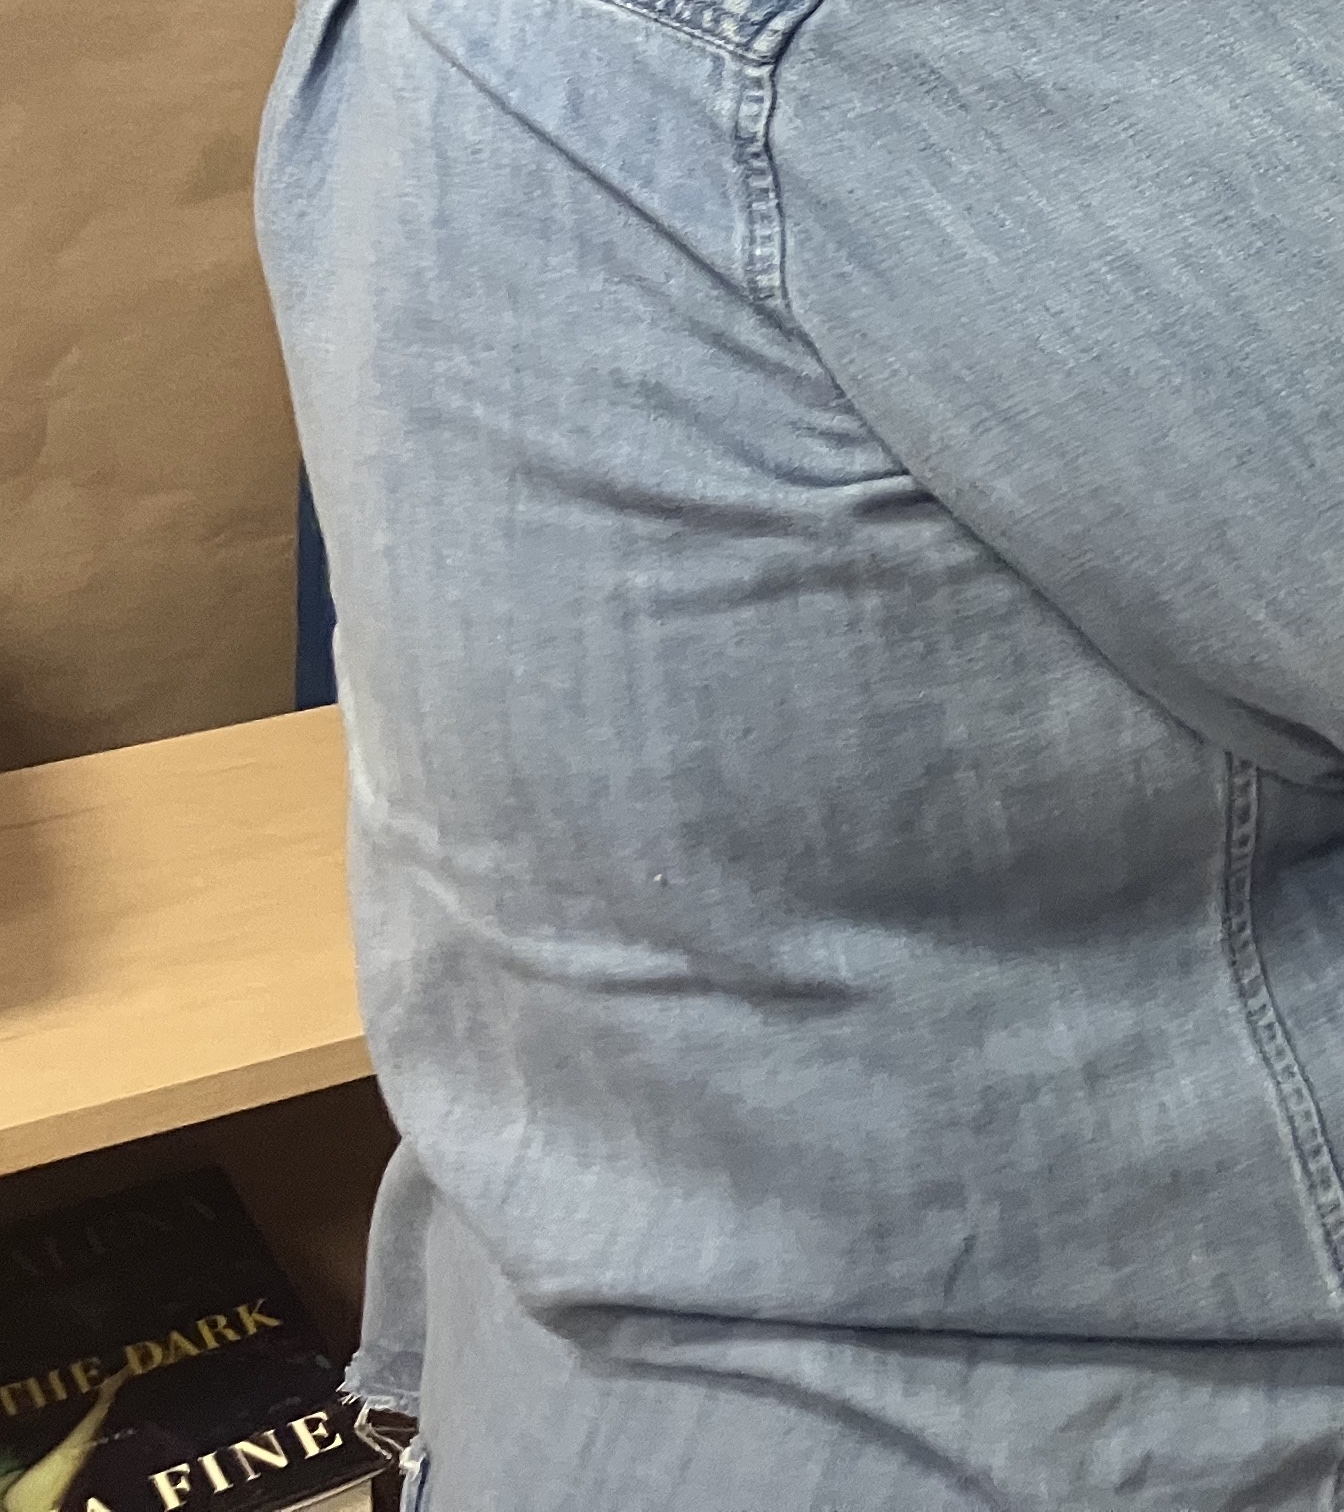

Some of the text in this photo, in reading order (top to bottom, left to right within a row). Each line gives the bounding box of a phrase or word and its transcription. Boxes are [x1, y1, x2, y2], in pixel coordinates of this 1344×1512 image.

[0, 1298, 283, 1417] THE DARK
[149, 1411, 344, 1511] FINE
